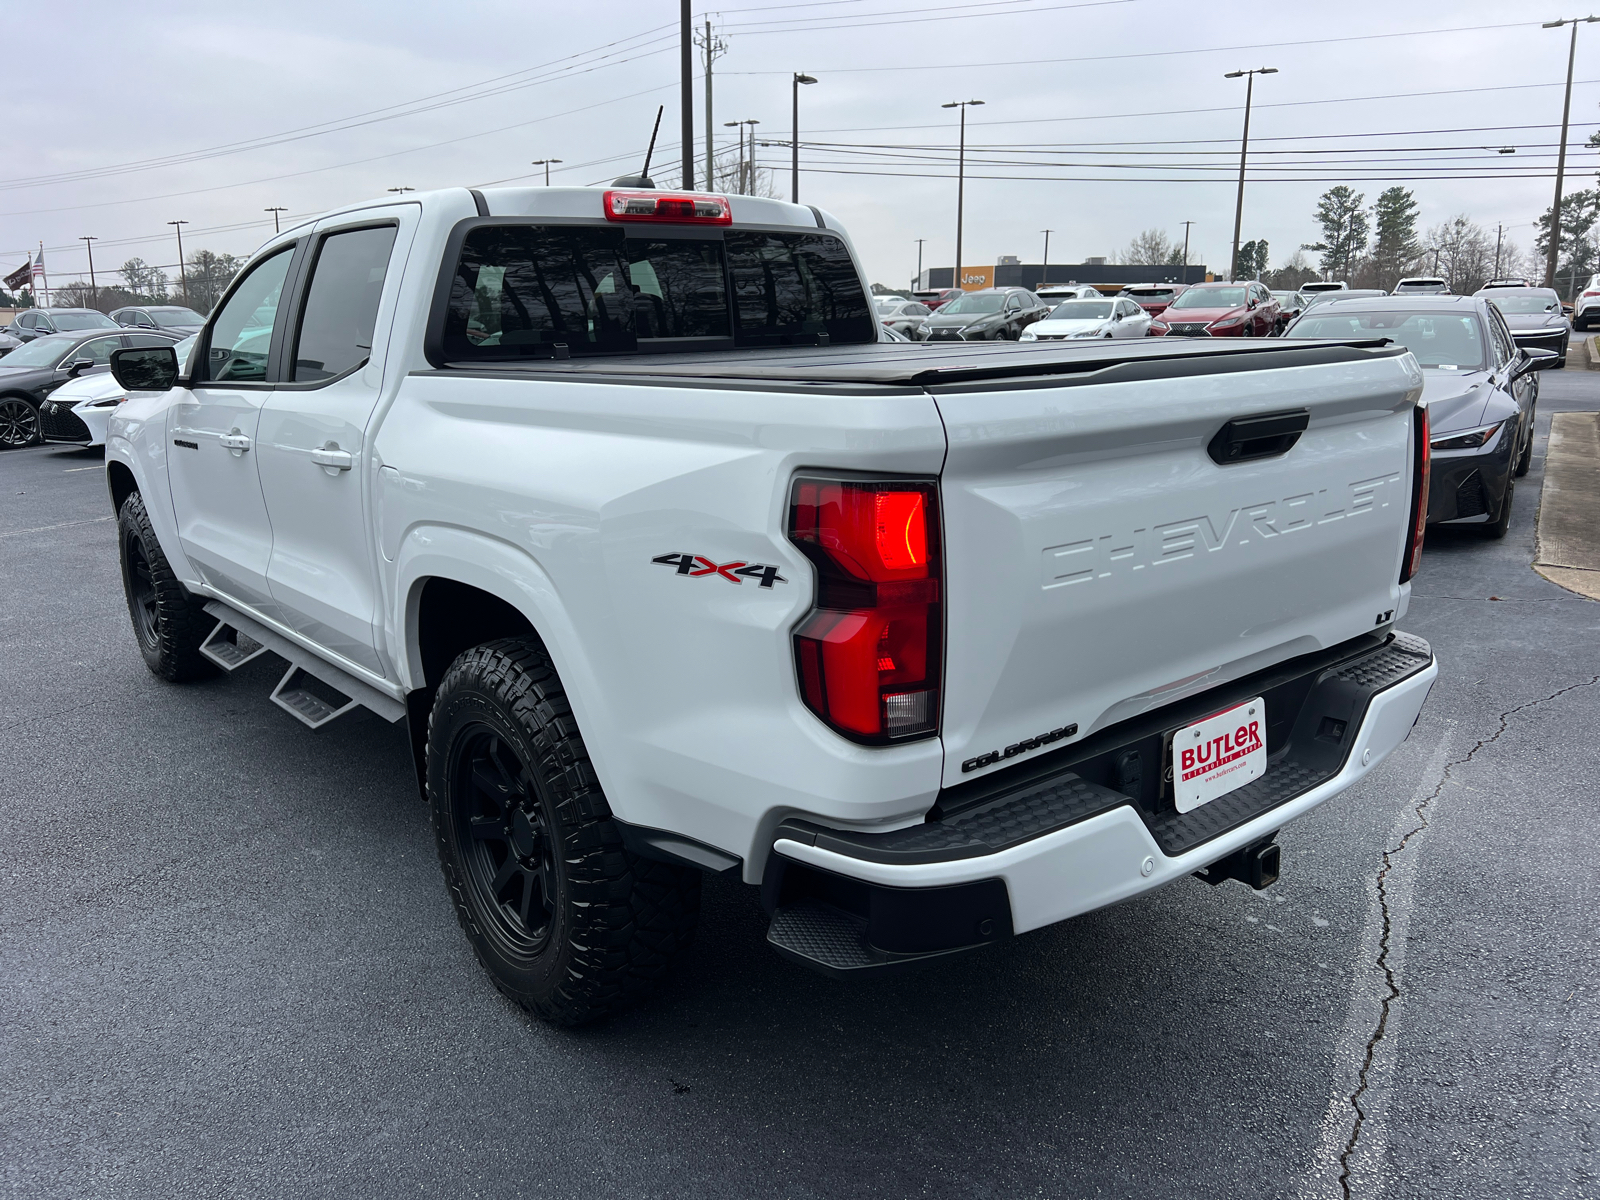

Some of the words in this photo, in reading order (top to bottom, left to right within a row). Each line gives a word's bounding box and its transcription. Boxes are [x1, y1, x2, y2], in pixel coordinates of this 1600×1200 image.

[961, 273, 986, 286] Jeep
[1041, 472, 1400, 590] CHEVROLET
[1375, 609, 1394, 625] LT
[961, 722, 1079, 773] COLORADO
[1182, 755, 1234, 781] AUTOMOTIVE
[1240, 741, 1262, 757] GROUP
[1204, 761, 1247, 783] www.butlercars.com
